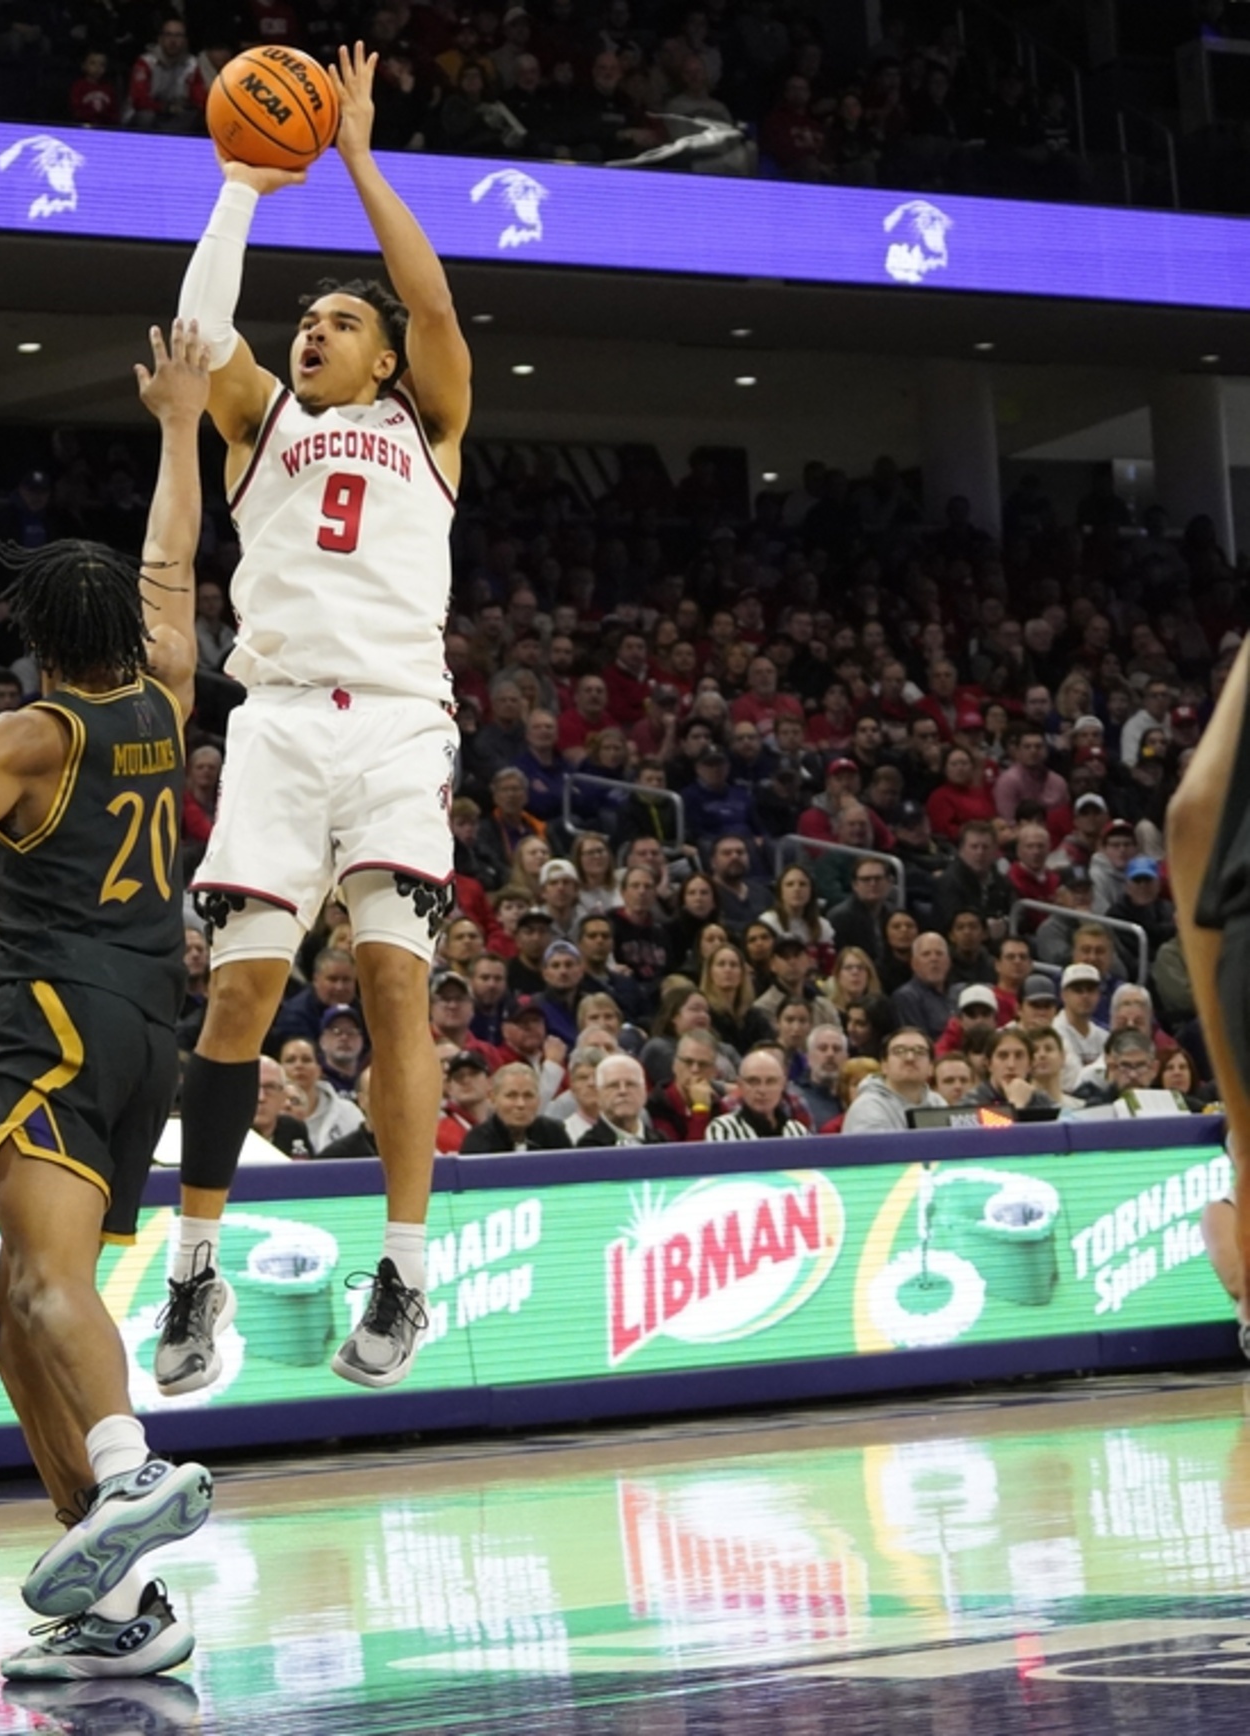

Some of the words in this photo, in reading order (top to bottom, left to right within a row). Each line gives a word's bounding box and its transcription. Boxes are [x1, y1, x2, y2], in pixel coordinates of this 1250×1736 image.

[239, 72, 293, 126] NCAA
[261, 47, 324, 113] Wilson
[280, 430, 413, 482] WISCONSIN
[317, 472, 368, 554] 9
[112, 736, 176, 777] MULLINS
[98, 786, 179, 906] 20
[1070, 1154, 1232, 1281] TORNADO
[456, 1263, 534, 1329] Mop
[612, 1185, 821, 1358] LIBMAN
[1094, 1246, 1159, 1315] Spin
[1163, 1219, 1207, 1271] Mo
